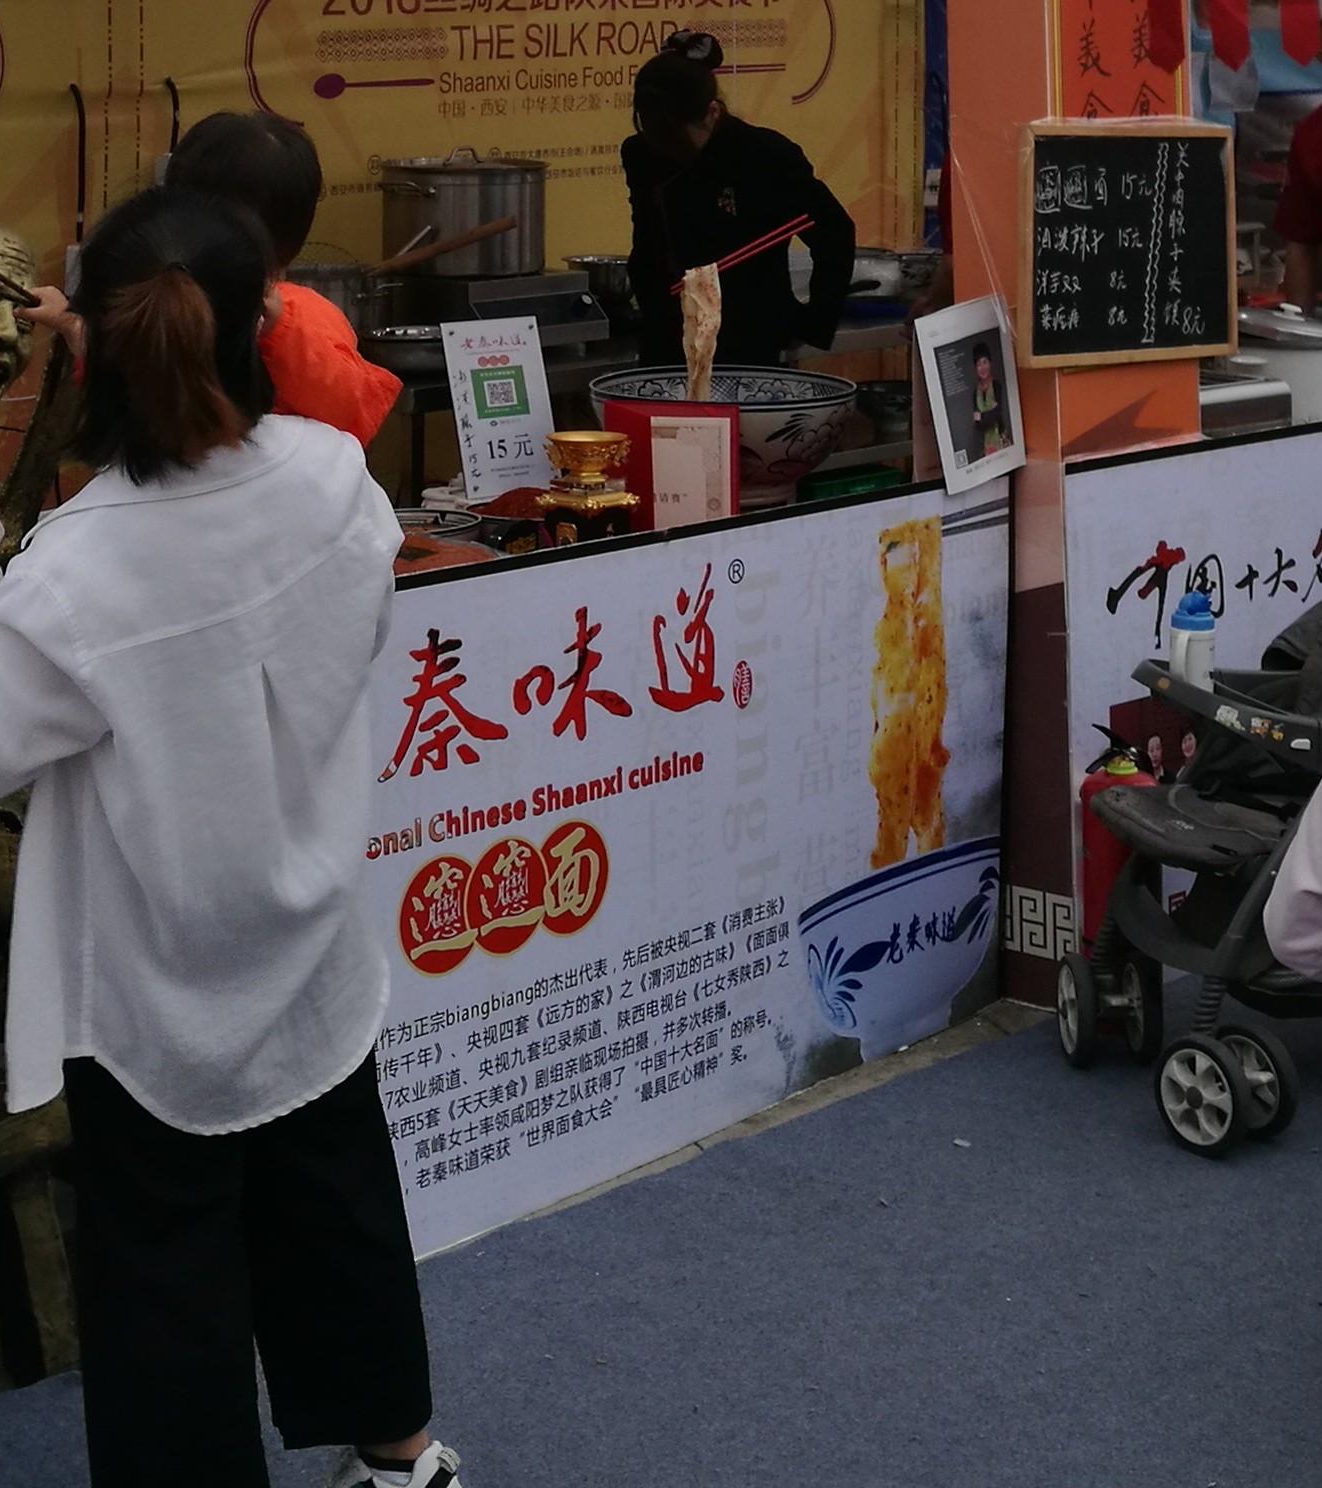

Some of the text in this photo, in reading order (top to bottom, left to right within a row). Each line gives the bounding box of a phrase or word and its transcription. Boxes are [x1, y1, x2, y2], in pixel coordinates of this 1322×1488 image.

[450, 25, 514, 61] THE
[524, 22, 589, 59] SILK
[439, 70, 510, 94] Shaanxi
[515, 68, 578, 91] Cuisine
[582, 66, 623, 88] Food
[486, 433, 534, 460] 15 元
[377, 562, 725, 783] 秦味道
[429, 800, 526, 844] Chinese
[531, 770, 623, 817] Shaanxi
[628, 749, 705, 789] cuisine
